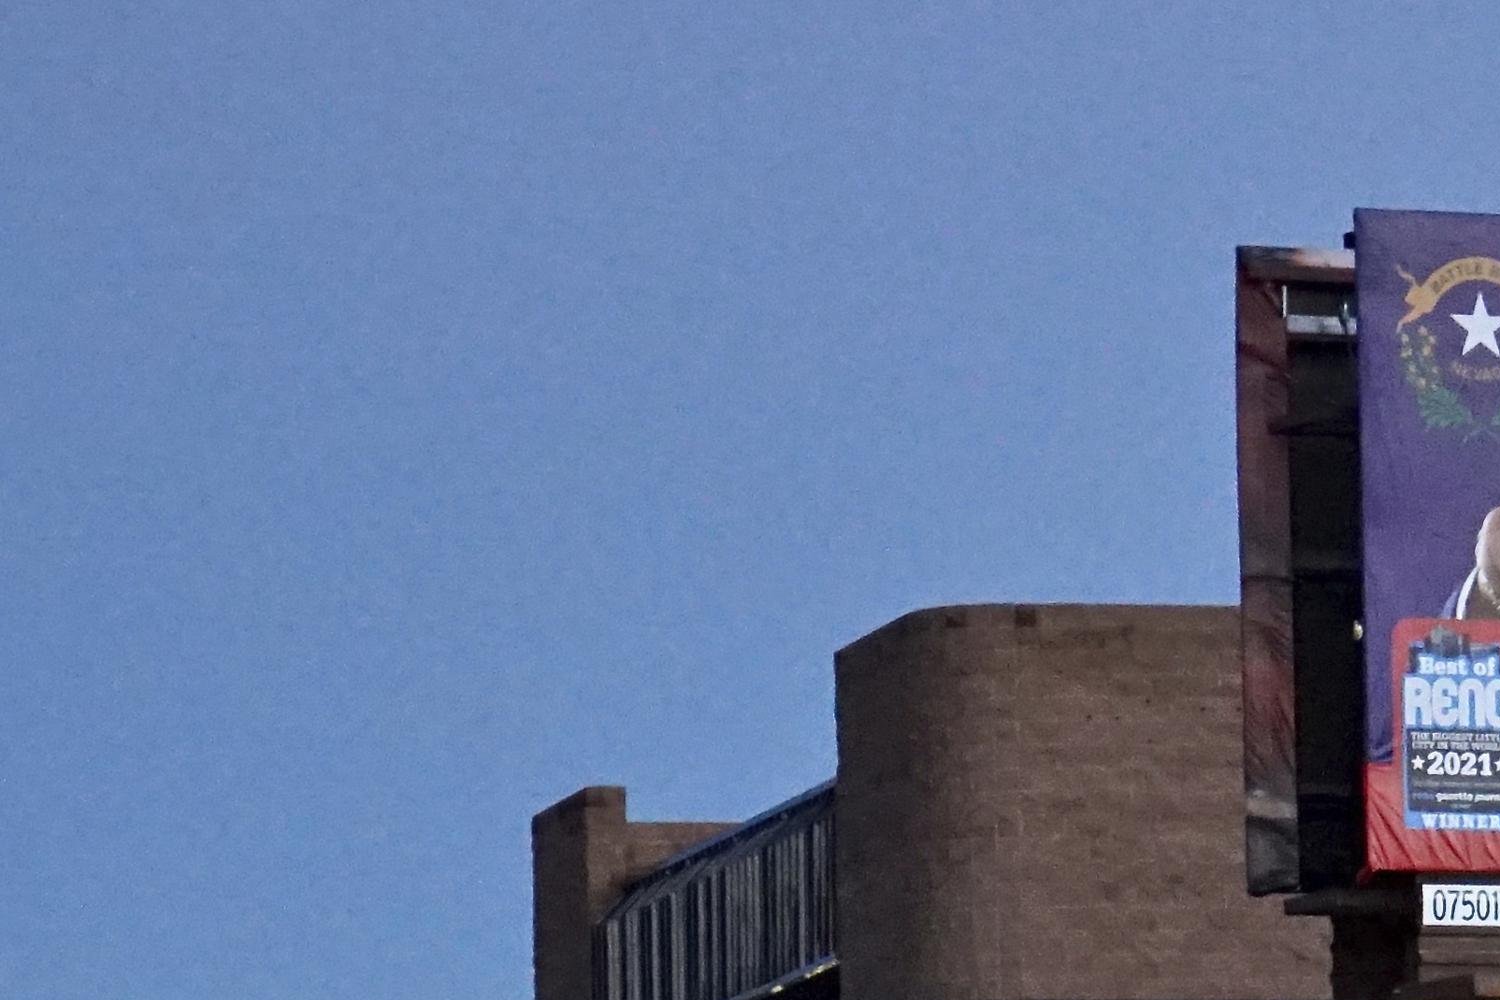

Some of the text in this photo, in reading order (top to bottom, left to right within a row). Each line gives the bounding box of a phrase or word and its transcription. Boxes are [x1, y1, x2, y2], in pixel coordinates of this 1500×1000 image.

[1418, 656, 1497, 676] Best of
[1427, 751, 1493, 776] 2021
